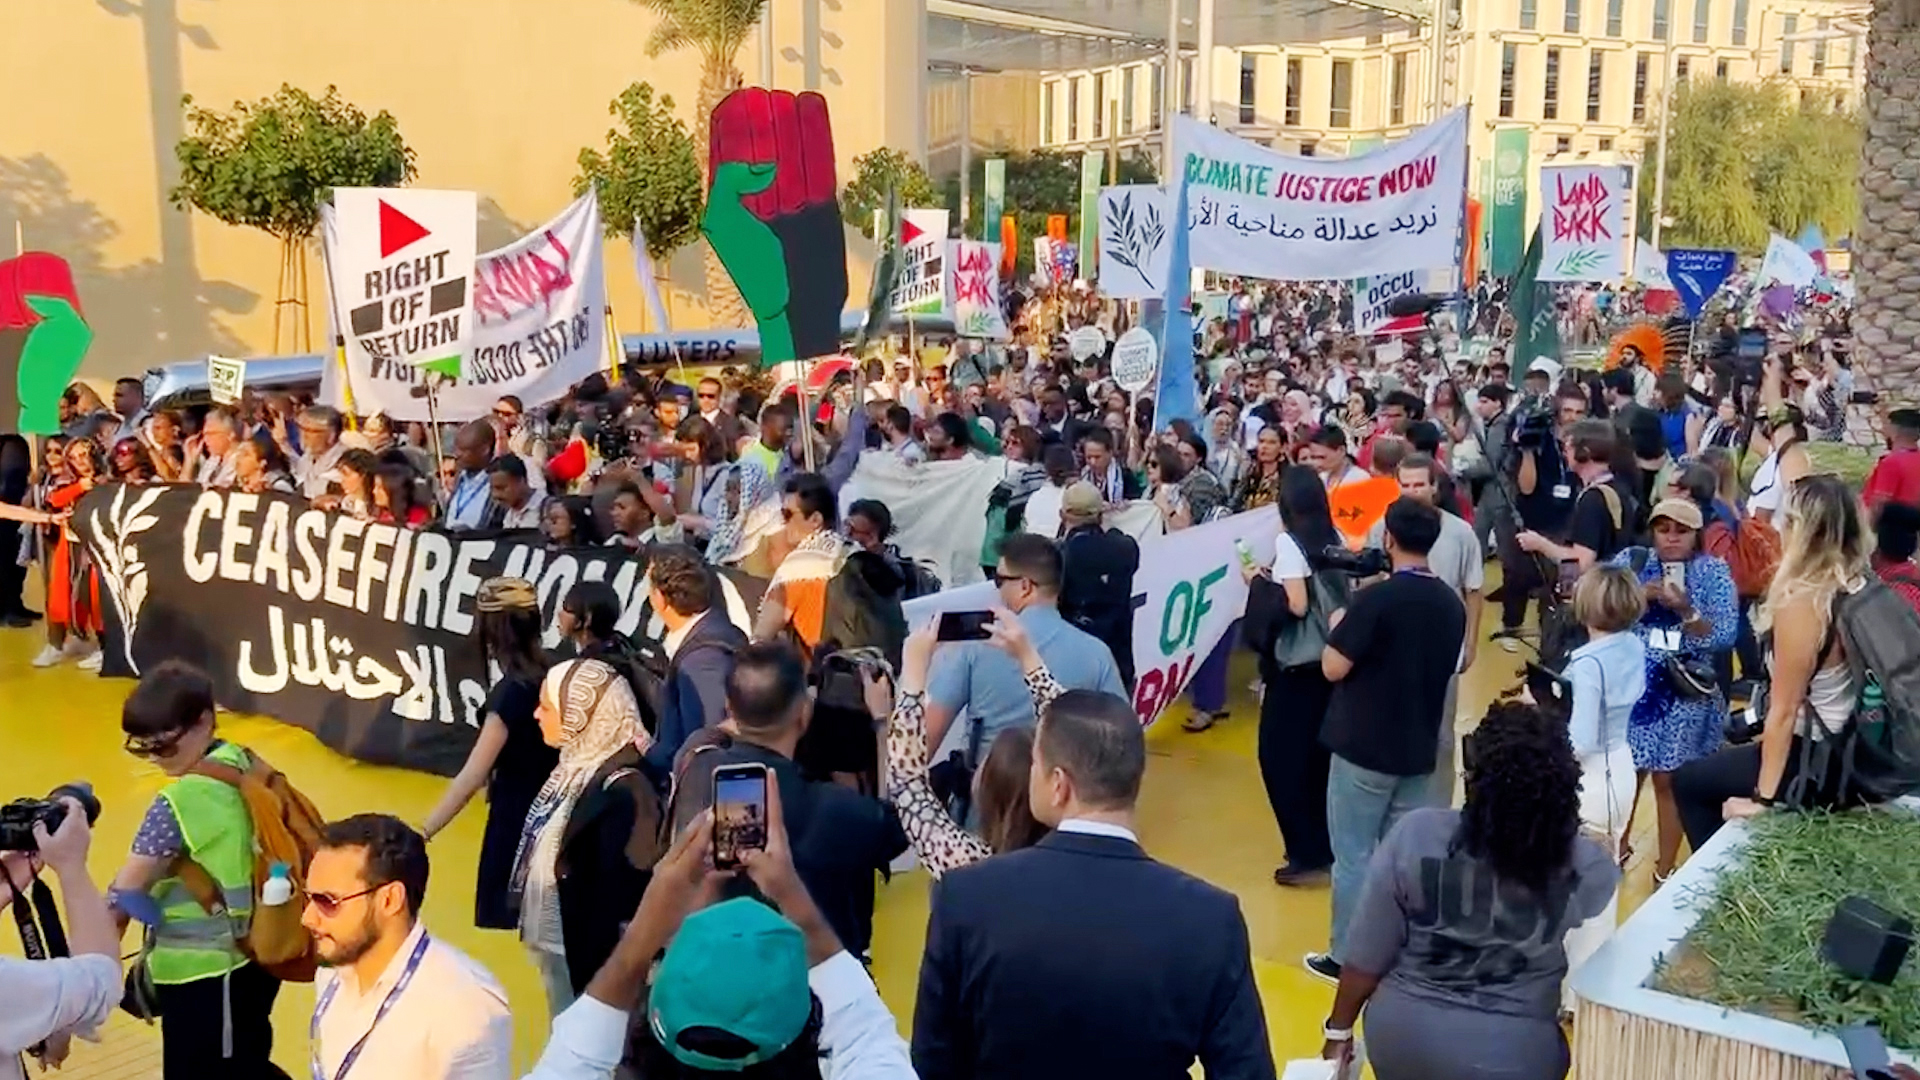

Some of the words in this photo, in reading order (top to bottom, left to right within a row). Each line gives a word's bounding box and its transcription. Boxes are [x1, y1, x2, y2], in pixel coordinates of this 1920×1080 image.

[1275, 169, 1375, 203] JUSTICE
[1379, 154, 1437, 198] NOW
[1557, 172, 1609, 206] LAND
[1314, 217, 1380, 241] عدالة
[1389, 204, 1437, 235] نريد
[1552, 204, 1612, 244] BACK
[365, 249, 450, 299] RIGHT
[902, 265, 920, 285] OF
[1368, 270, 1414, 305] OCCU
[389, 291, 424, 325] OF
[890, 278, 940, 307] ETURN
[360, 315, 460, 359] RETURN
[634, 339, 737, 363] LUTERS
[183, 490, 496, 635] CEASEFIRE
[1159, 563, 1229, 656] OF
[237, 605, 454, 724] الاحتلال
